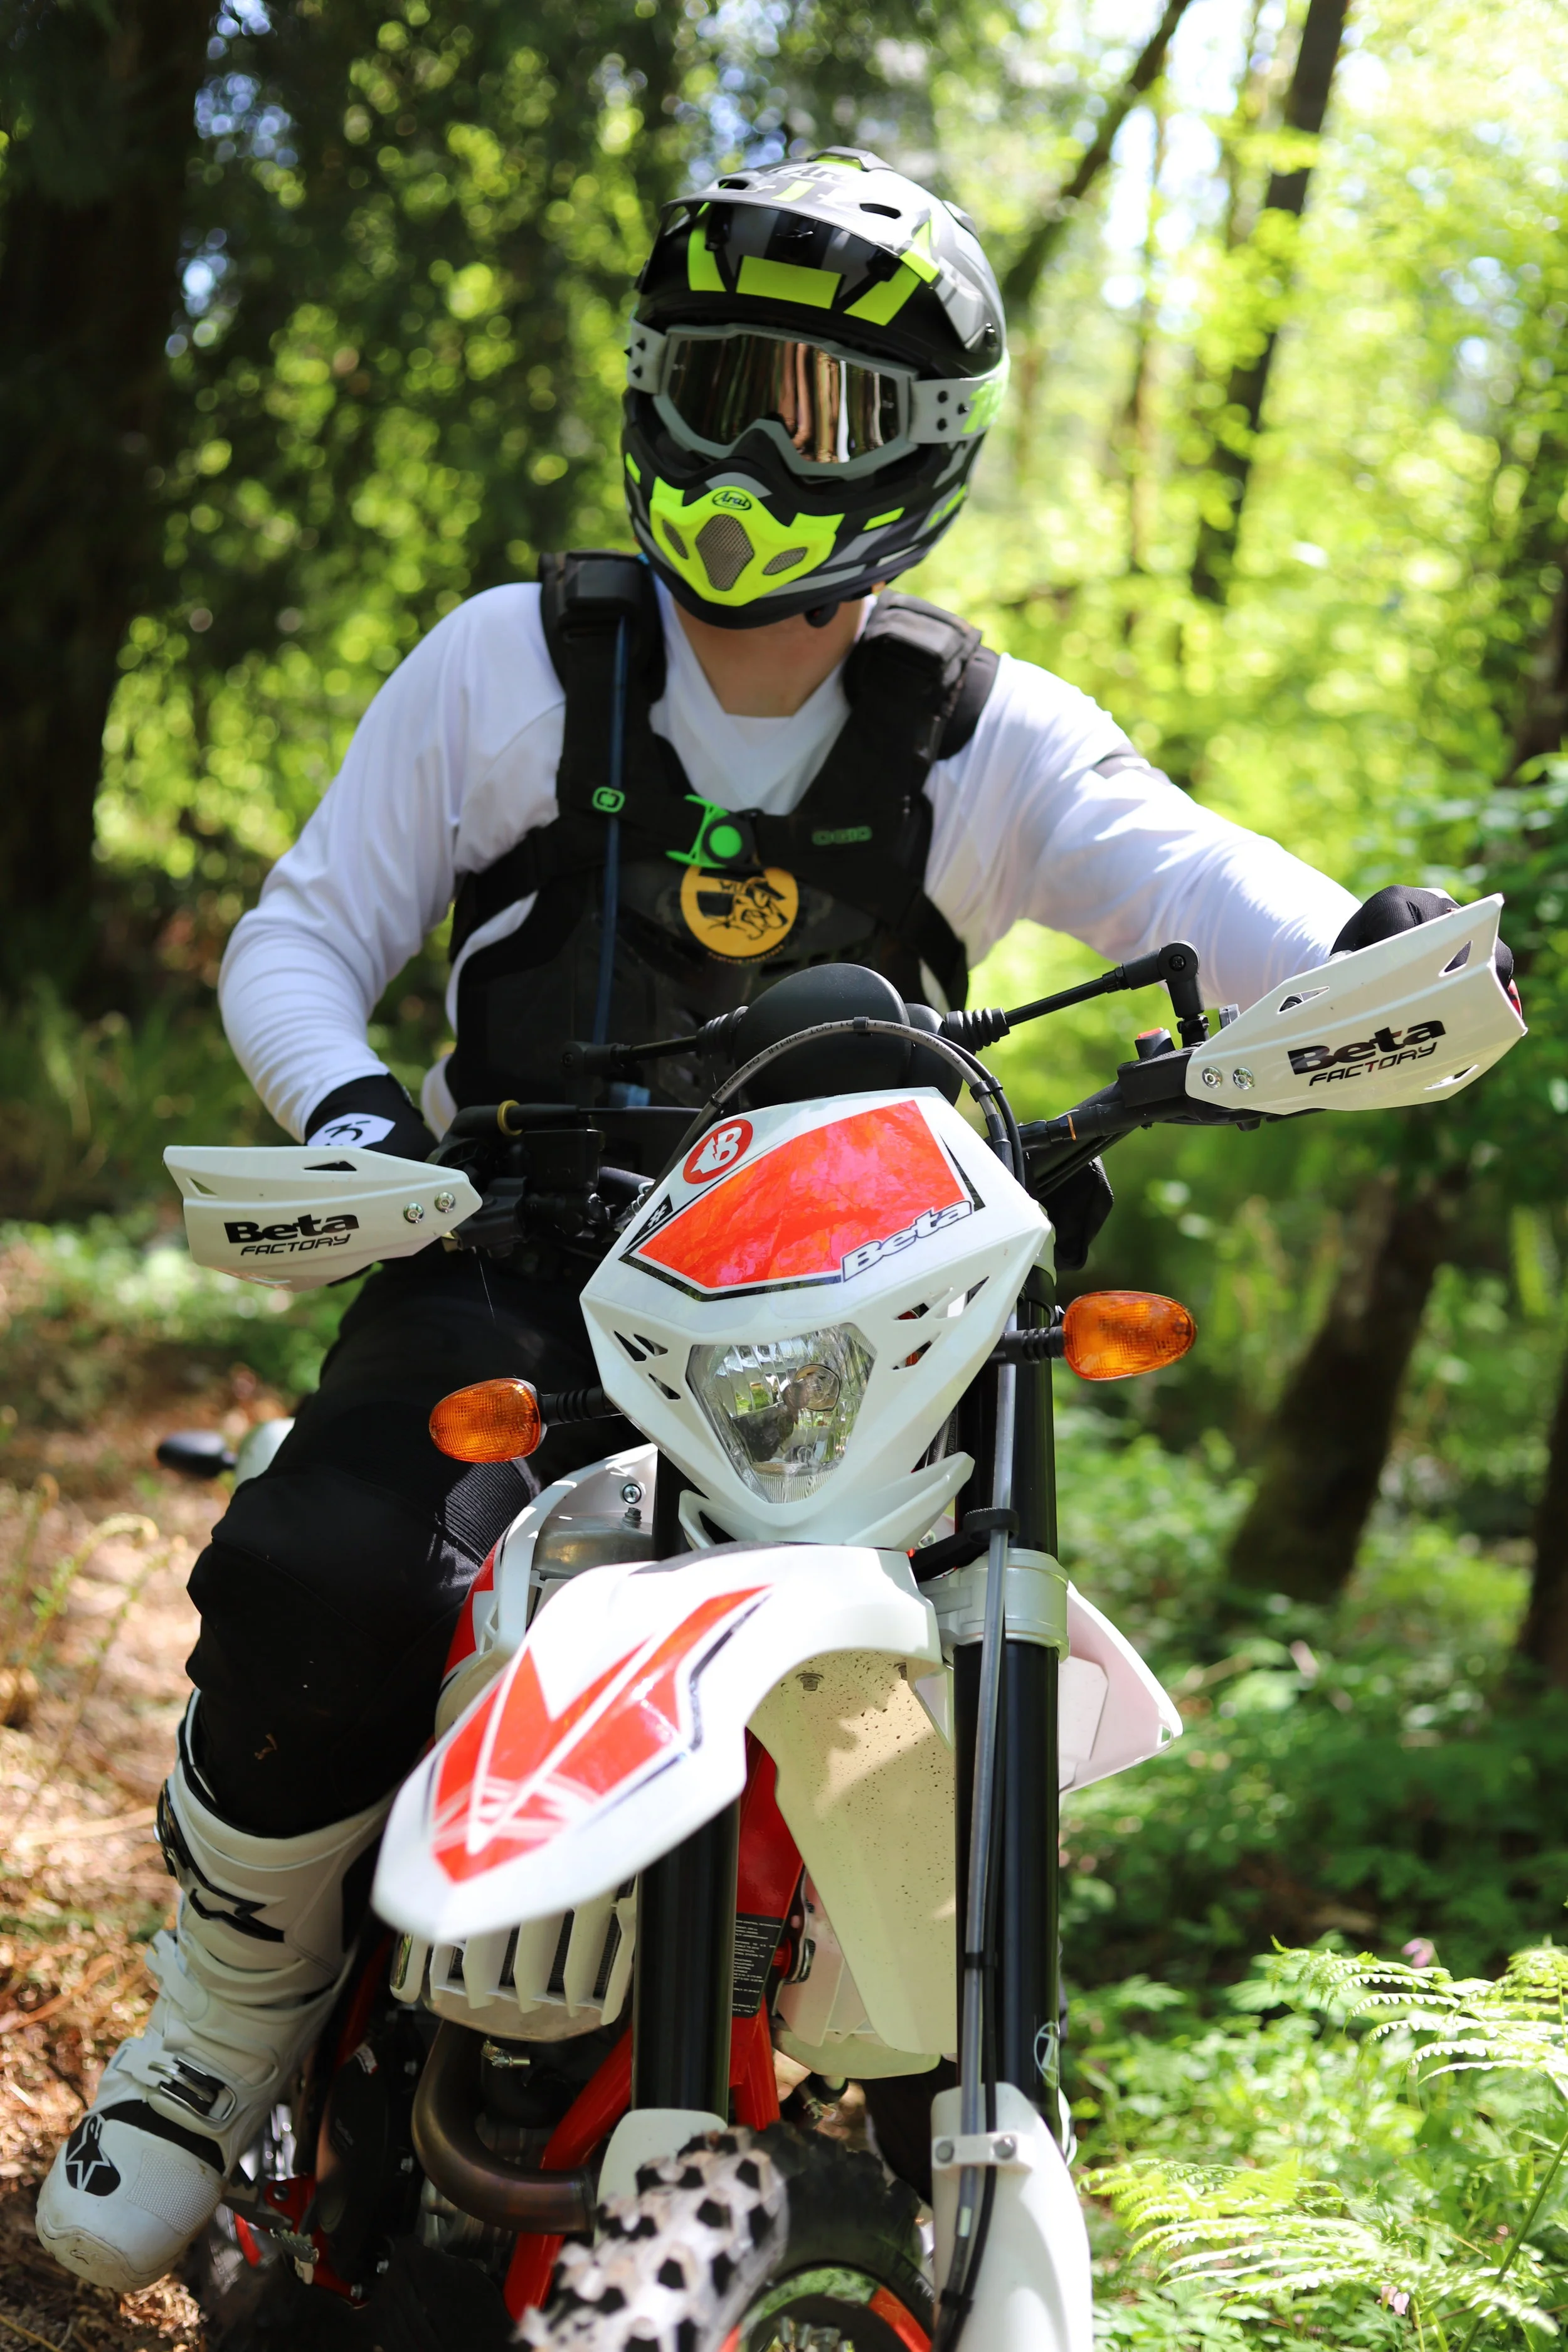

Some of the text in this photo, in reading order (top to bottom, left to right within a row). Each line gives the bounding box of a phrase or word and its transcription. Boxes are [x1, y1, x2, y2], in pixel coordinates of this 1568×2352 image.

[714, 492, 748, 507] Arai
[808, 1024, 834, 1035] DOT
[1288, 1020, 1446, 1075] Beta
[1309, 1042, 1437, 1087] FACTORY
[224, 1214, 359, 1244] Beta
[841, 1200, 973, 1283] Beta
[240, 1234, 351, 1256] FACTORY
